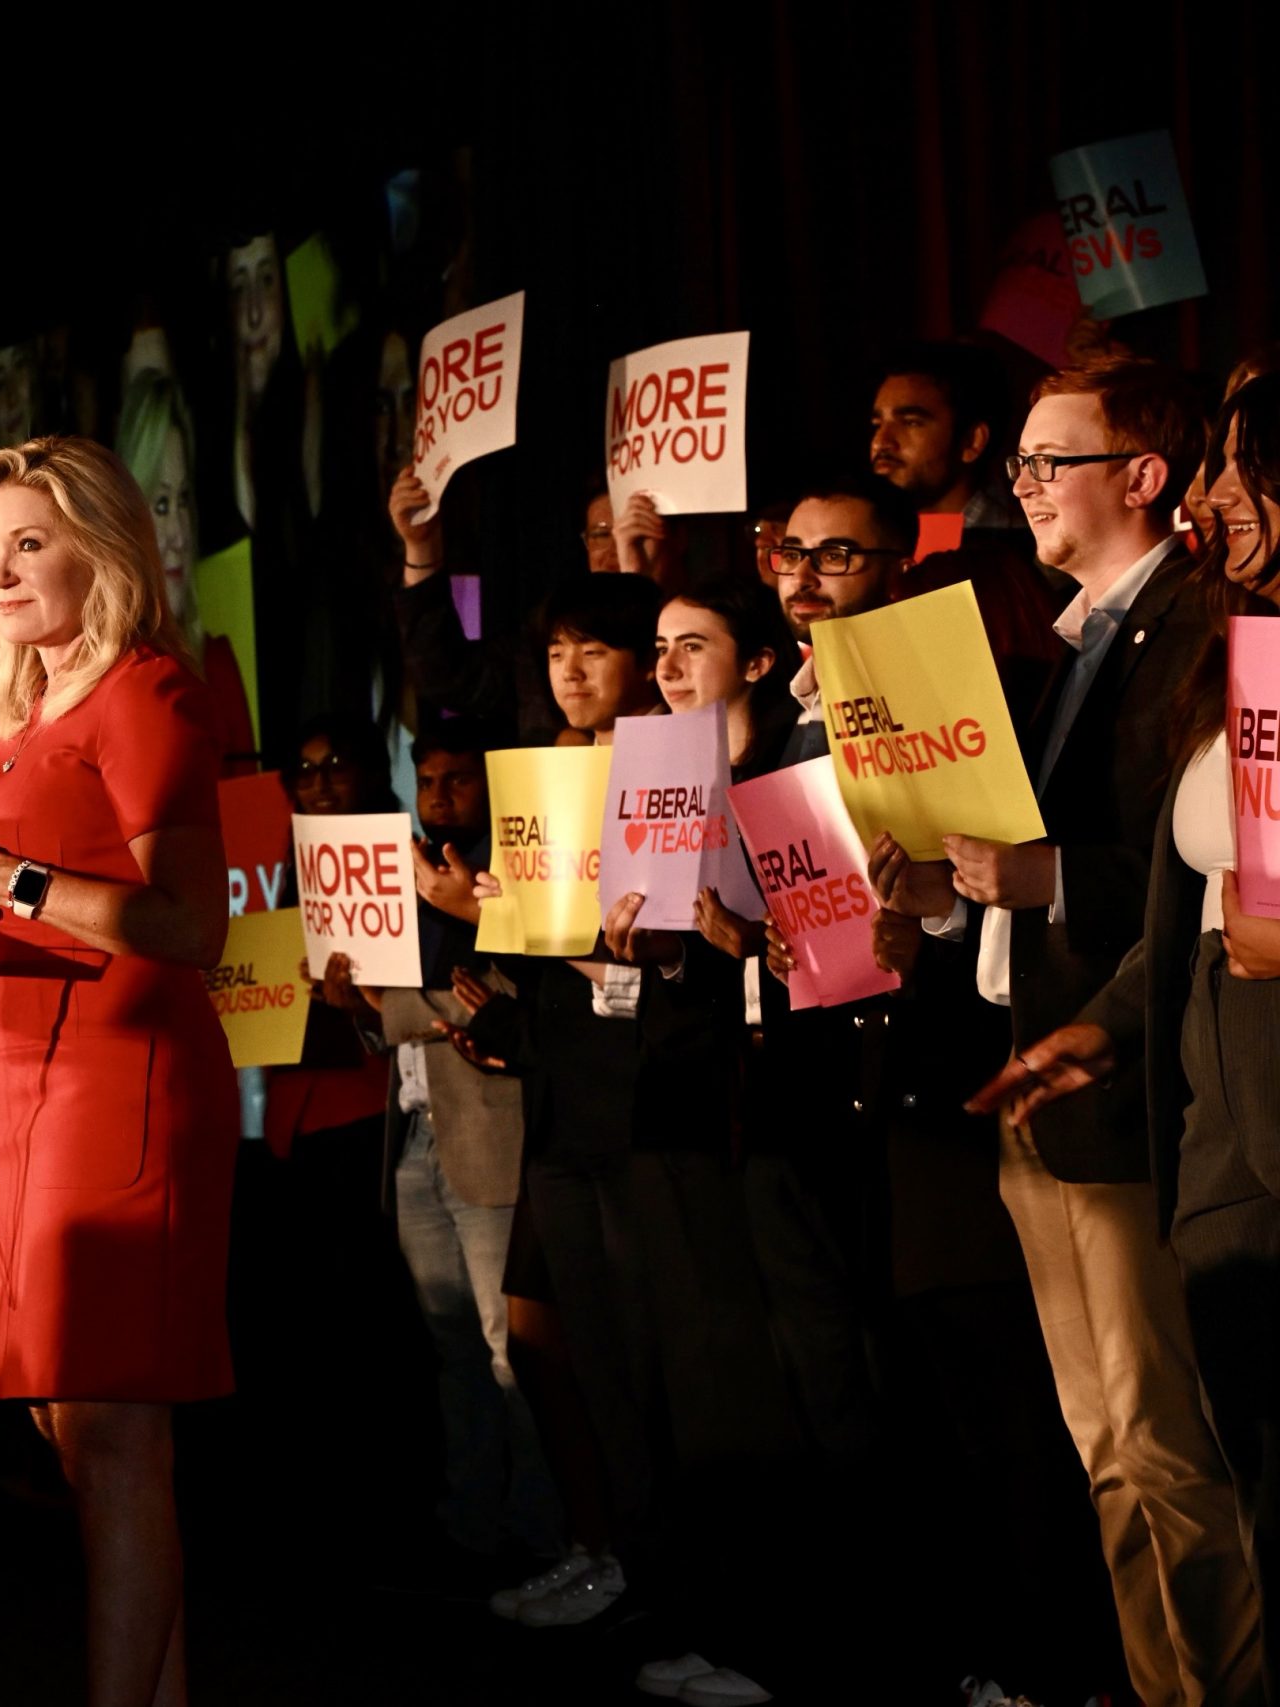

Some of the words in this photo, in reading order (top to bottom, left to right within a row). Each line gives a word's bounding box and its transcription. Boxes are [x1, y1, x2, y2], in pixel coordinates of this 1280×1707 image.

[1059, 179, 1168, 236] ERAL
[1070, 223, 1163, 276] SWs
[421, 322, 506, 411] ORE
[414, 414, 436, 464] OR
[438, 375, 503, 434] YOU
[611, 363, 730, 439] MORE
[610, 434, 645, 480] FOR
[651, 424, 726, 465] YOU
[827, 696, 905, 739] LIBERAL
[856, 717, 987, 779] HOUSING
[617, 784, 706, 820] LIBERAL
[499, 815, 556, 847] ERAL
[649, 814, 729, 854] TEACS
[299, 844, 402, 896] MORE
[757, 839, 828, 893] ERAL
[305, 901, 335, 937] FOR
[339, 902, 404, 937] YOU
[208, 962, 258, 992] ERAL
[213, 984, 295, 1017] OUSING
